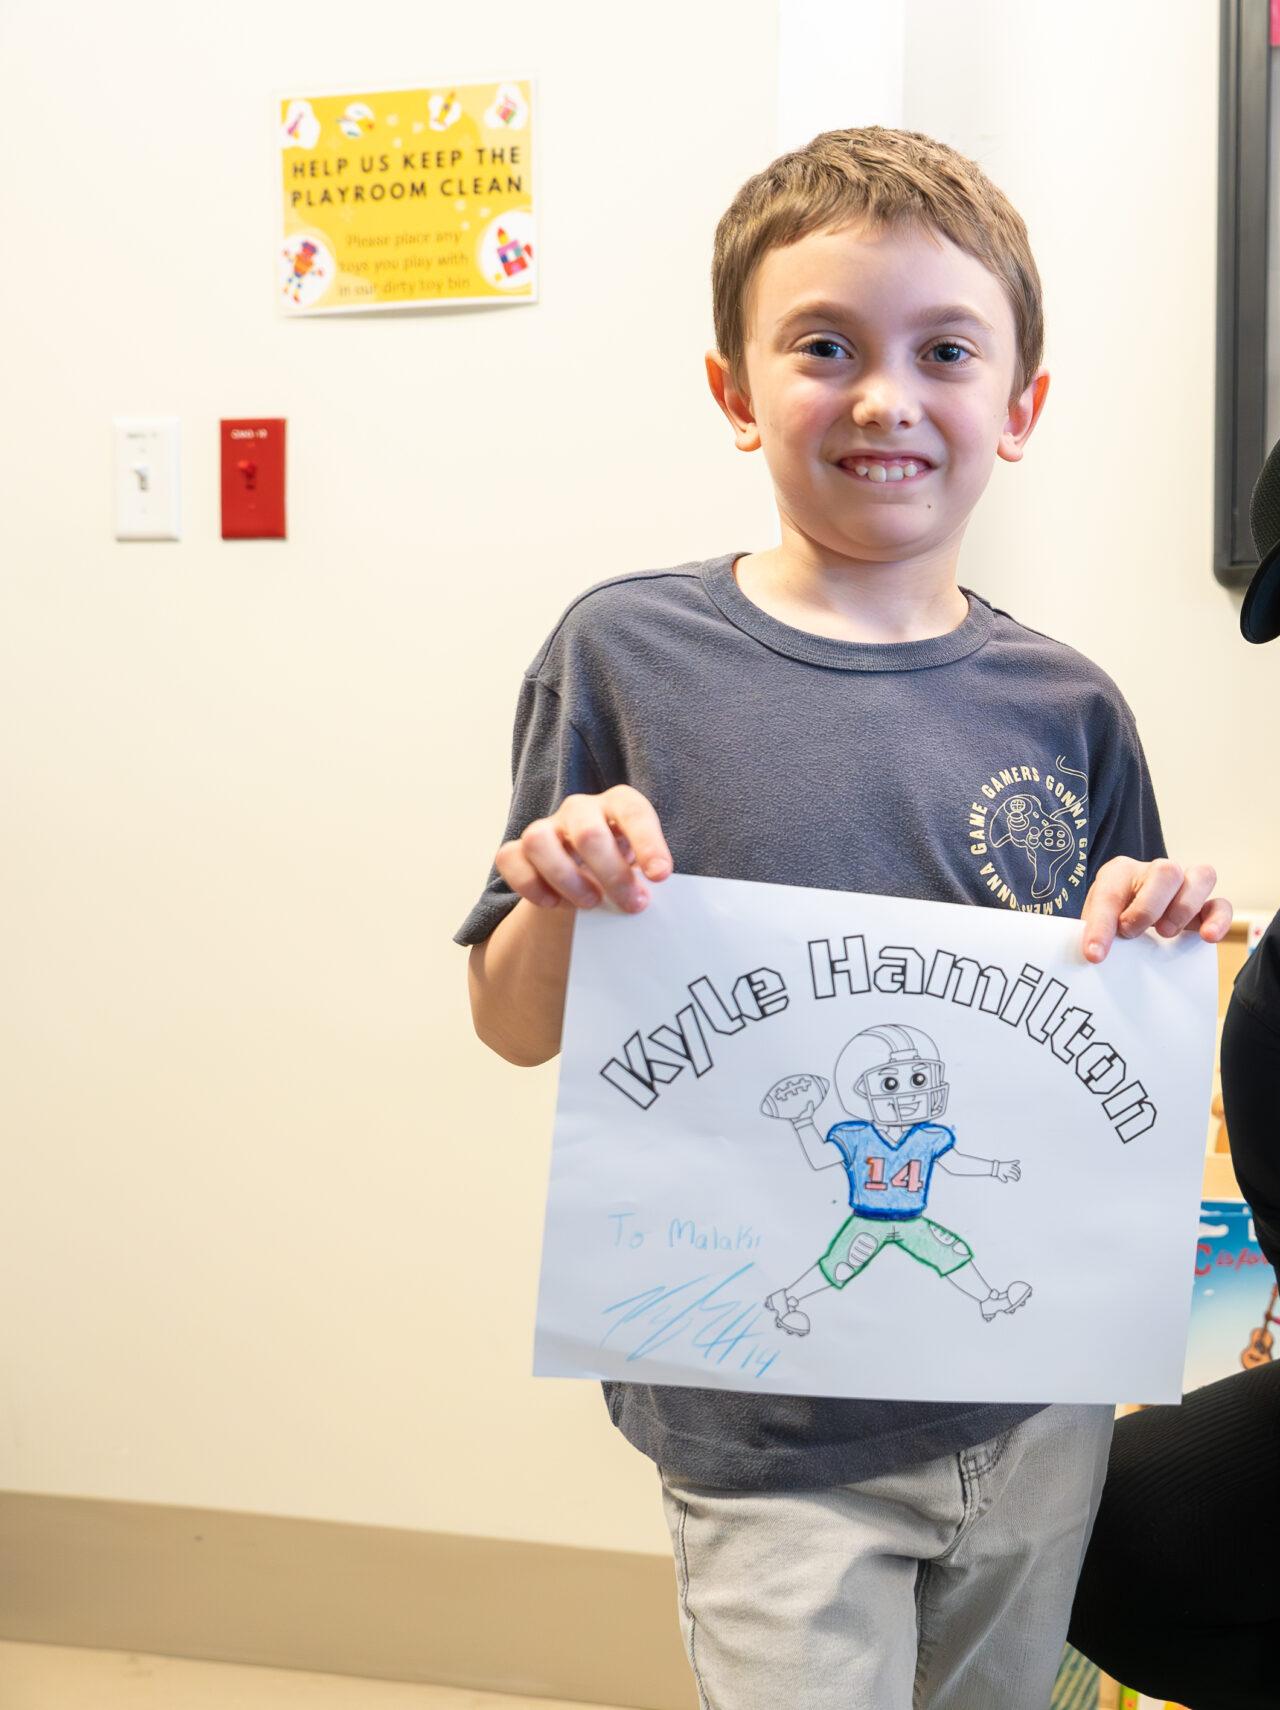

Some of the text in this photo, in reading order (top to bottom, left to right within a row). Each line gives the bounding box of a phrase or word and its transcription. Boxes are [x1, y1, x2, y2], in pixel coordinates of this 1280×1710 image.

[292, 146, 521, 179] HELP US KEEP THE
[291, 176, 523, 208] PLAYROOM CLEAN
[969, 802, 989, 856] GAME
[981, 766, 1088, 888] GAMERS GONNA GAME
[979, 861, 1018, 910] ONNA
[600, 935, 1158, 1143] Kyle Hamilton
[864, 1156, 924, 1192] 14
[608, 1212, 645, 1249] To
